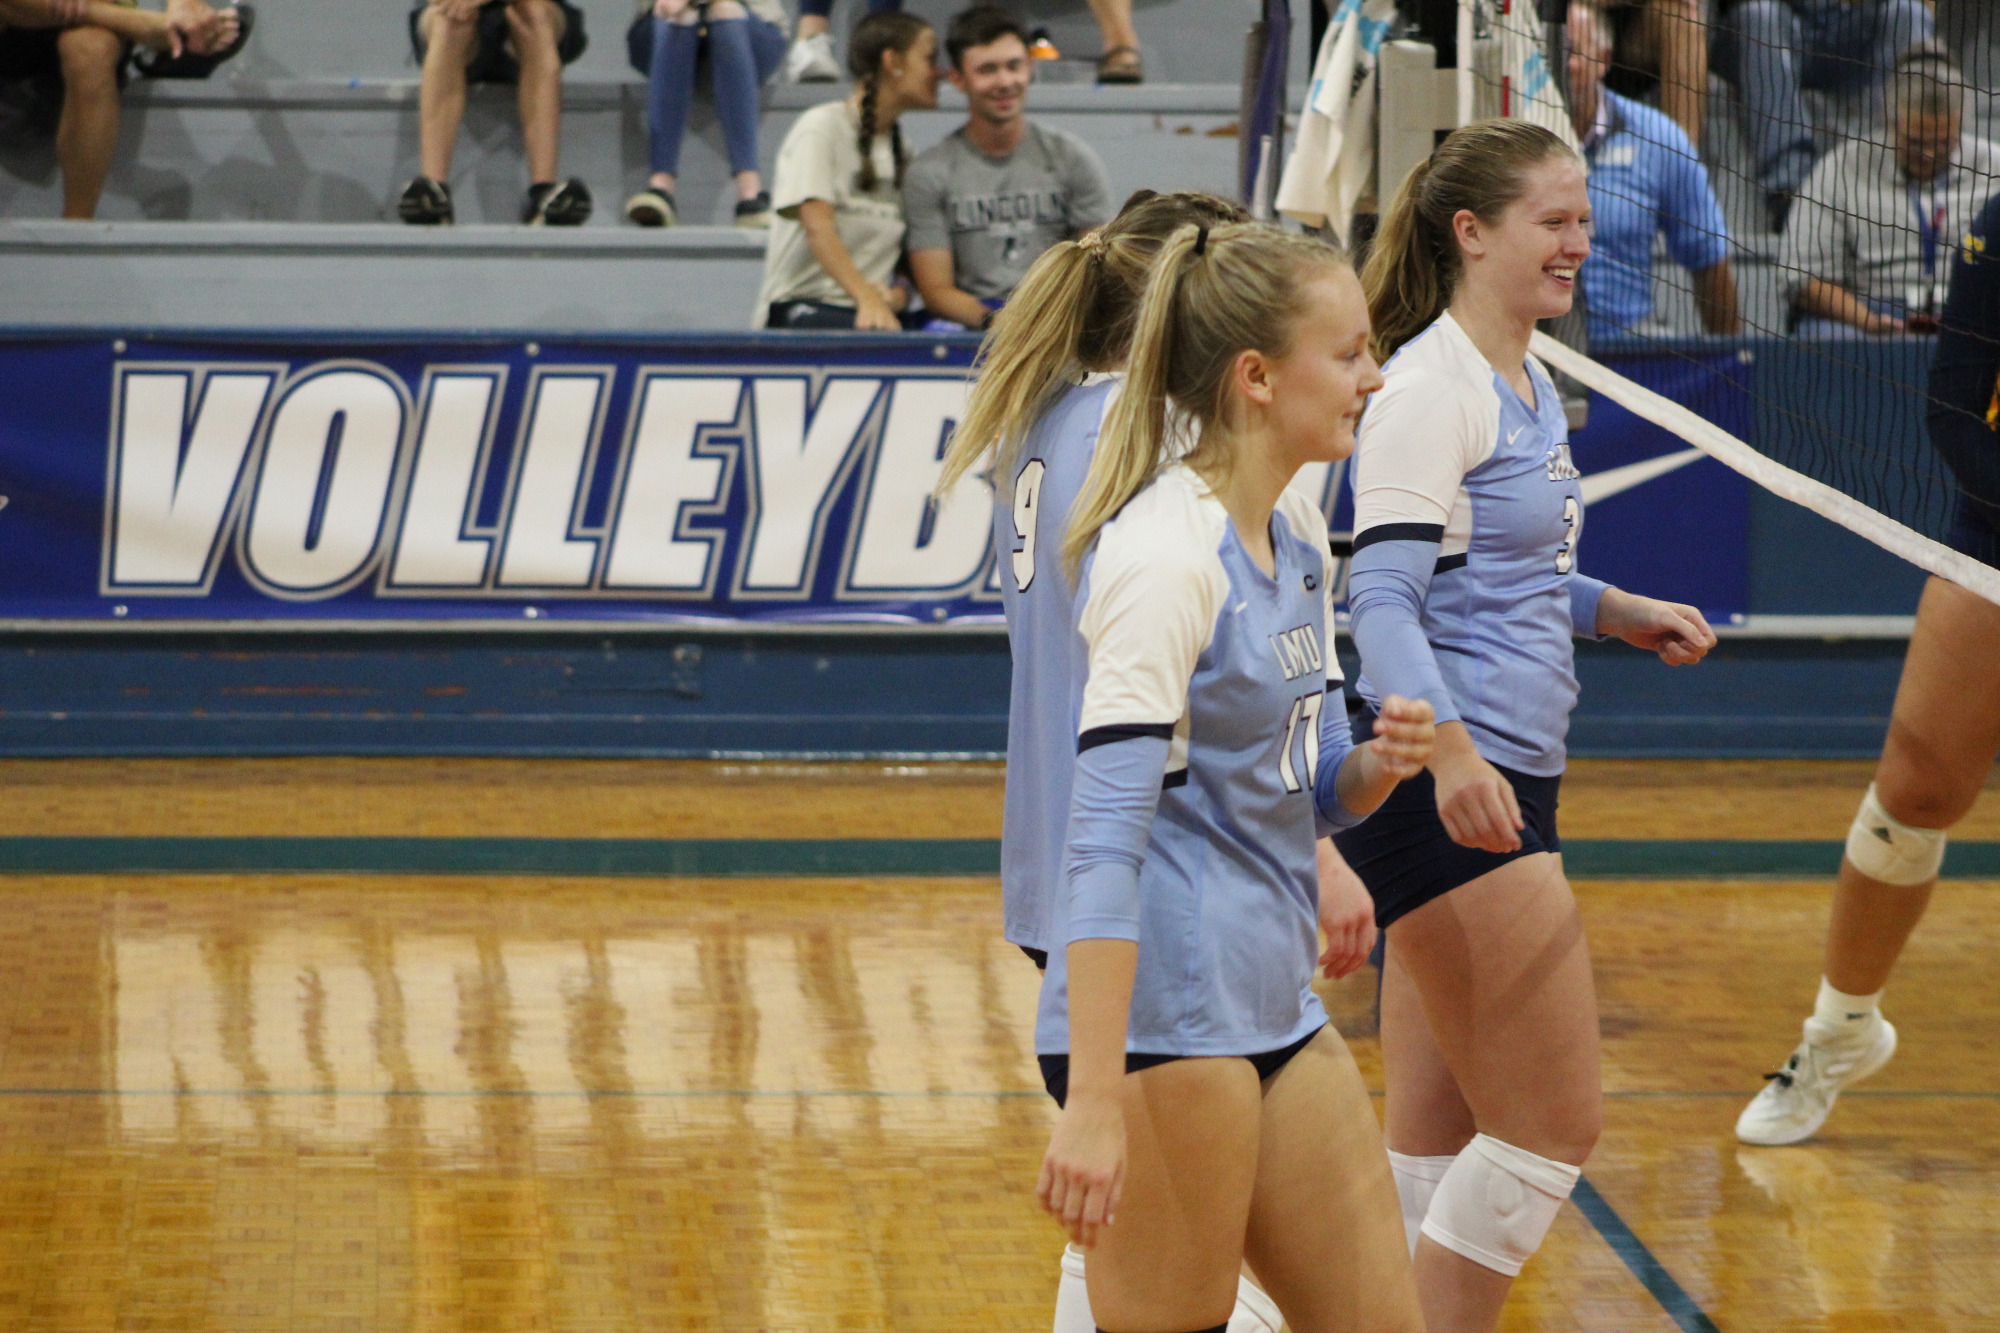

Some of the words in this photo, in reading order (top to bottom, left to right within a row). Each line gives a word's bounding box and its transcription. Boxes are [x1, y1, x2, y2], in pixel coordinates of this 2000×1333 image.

[951, 192, 1070, 228] LINCOLN
[1013, 457, 1046, 593] 9
[1555, 495, 1580, 576] 3
[1303, 574, 1317, 591] C
[1268, 623, 1323, 681] LMU
